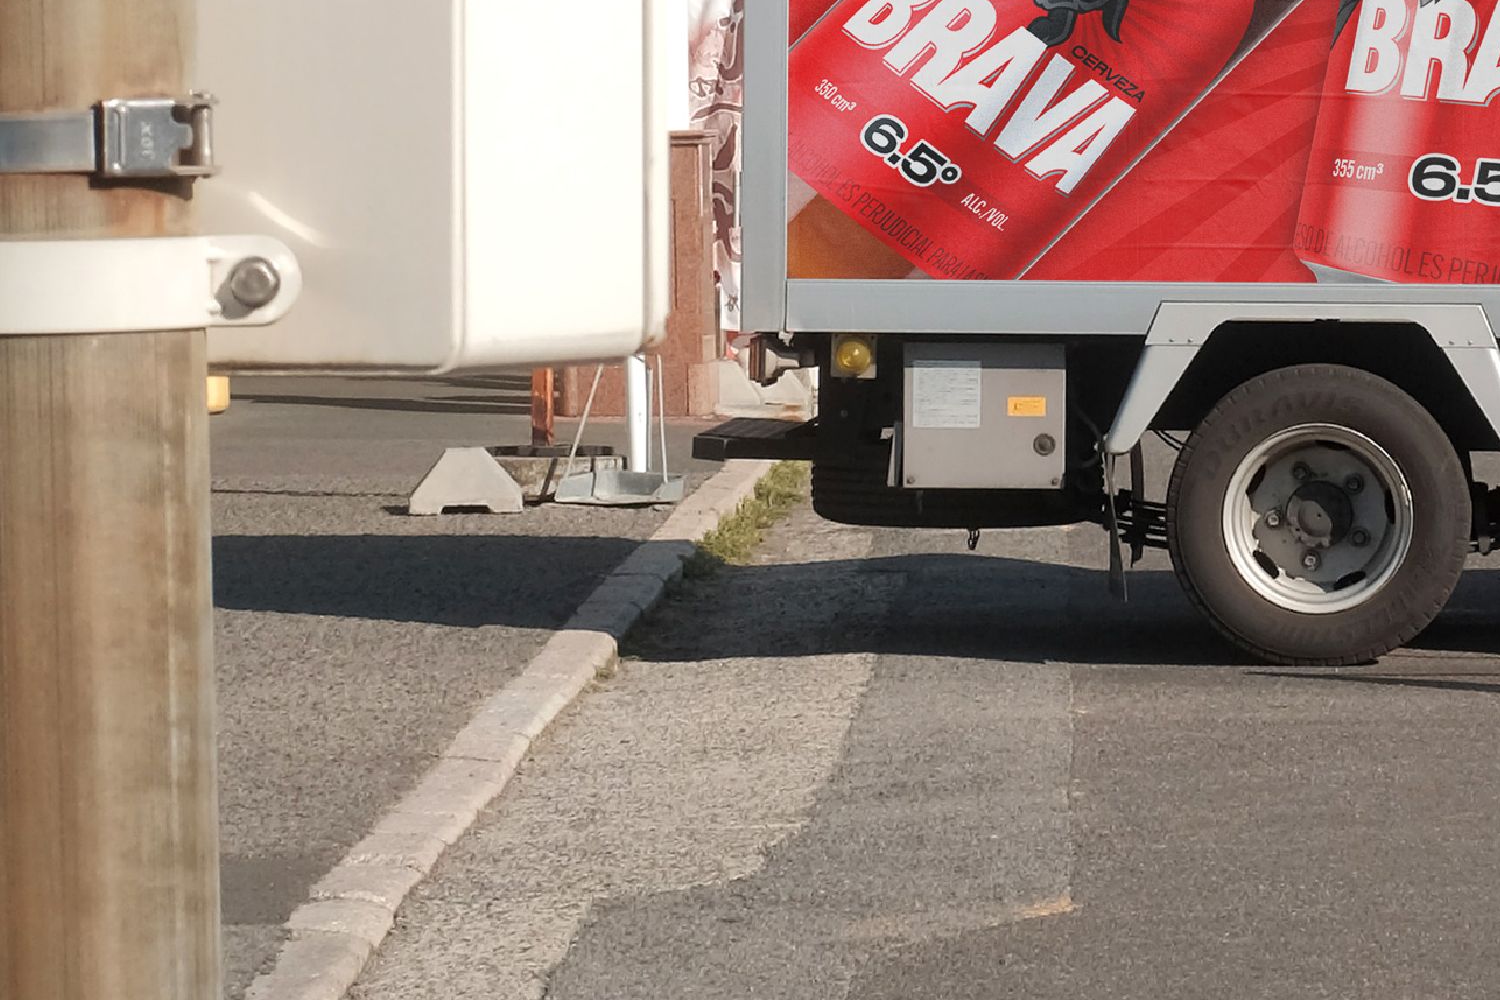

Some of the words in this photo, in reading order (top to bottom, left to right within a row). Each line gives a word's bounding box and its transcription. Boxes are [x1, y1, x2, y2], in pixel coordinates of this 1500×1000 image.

[1072, 44, 1147, 103] CERVEZA
[1332, 158, 1355, 179] 355
[851, 190, 937, 263] PERJUDICIAL
[1418, 251, 1445, 280] ES
